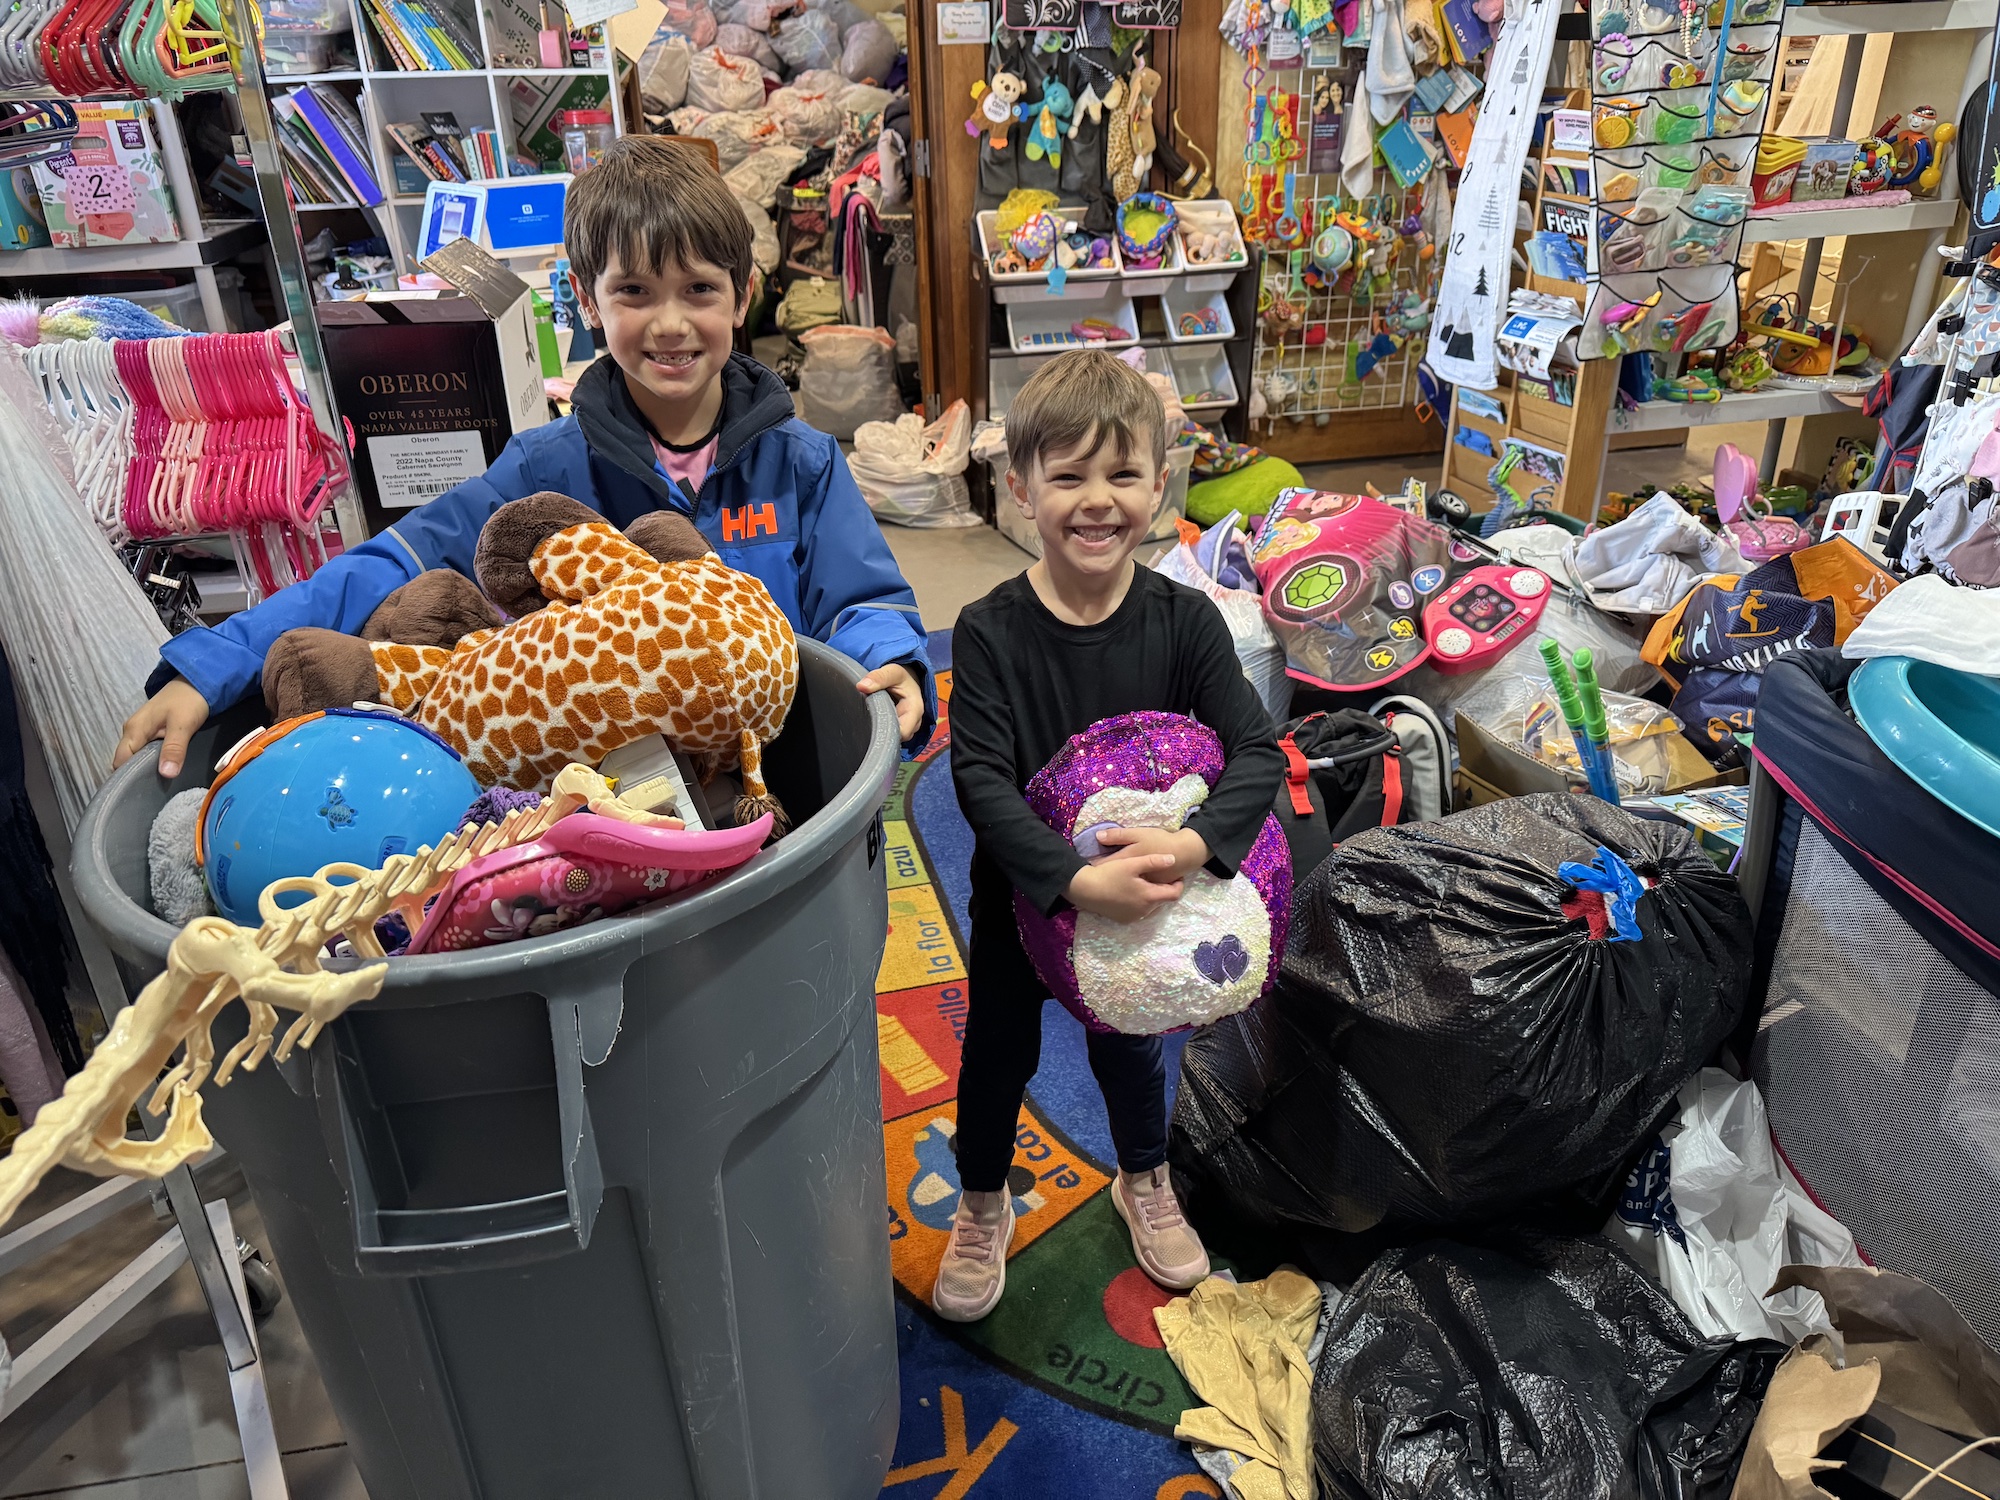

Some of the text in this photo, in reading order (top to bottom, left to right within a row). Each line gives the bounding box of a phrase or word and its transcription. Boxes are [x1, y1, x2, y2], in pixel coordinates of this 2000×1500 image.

[89, 174, 111, 199] 2
[1546, 212, 1589, 237] FIGHT
[60, 232, 71, 243] 2
[1449, 231, 1465, 256] 12
[359, 371, 468, 395] OBERON
[520, 374, 540, 417] OBERON
[361, 418, 498, 433] NAPA VALLEY ROOTS
[368, 407, 471, 421] OVER 45 YEARS
[410, 436, 440, 444] Oberon
[414, 457, 434, 465] Napa
[435, 455, 462, 463] County
[428, 462, 463, 470] Sauvignon
[722, 502, 778, 542] HH
[884, 845, 918, 878] azul
[916, 919, 956, 975] la flor
[1038, 1163, 1081, 1189] el
[1626, 1199, 1652, 1210] and
[1047, 1343, 1166, 1407] circle
